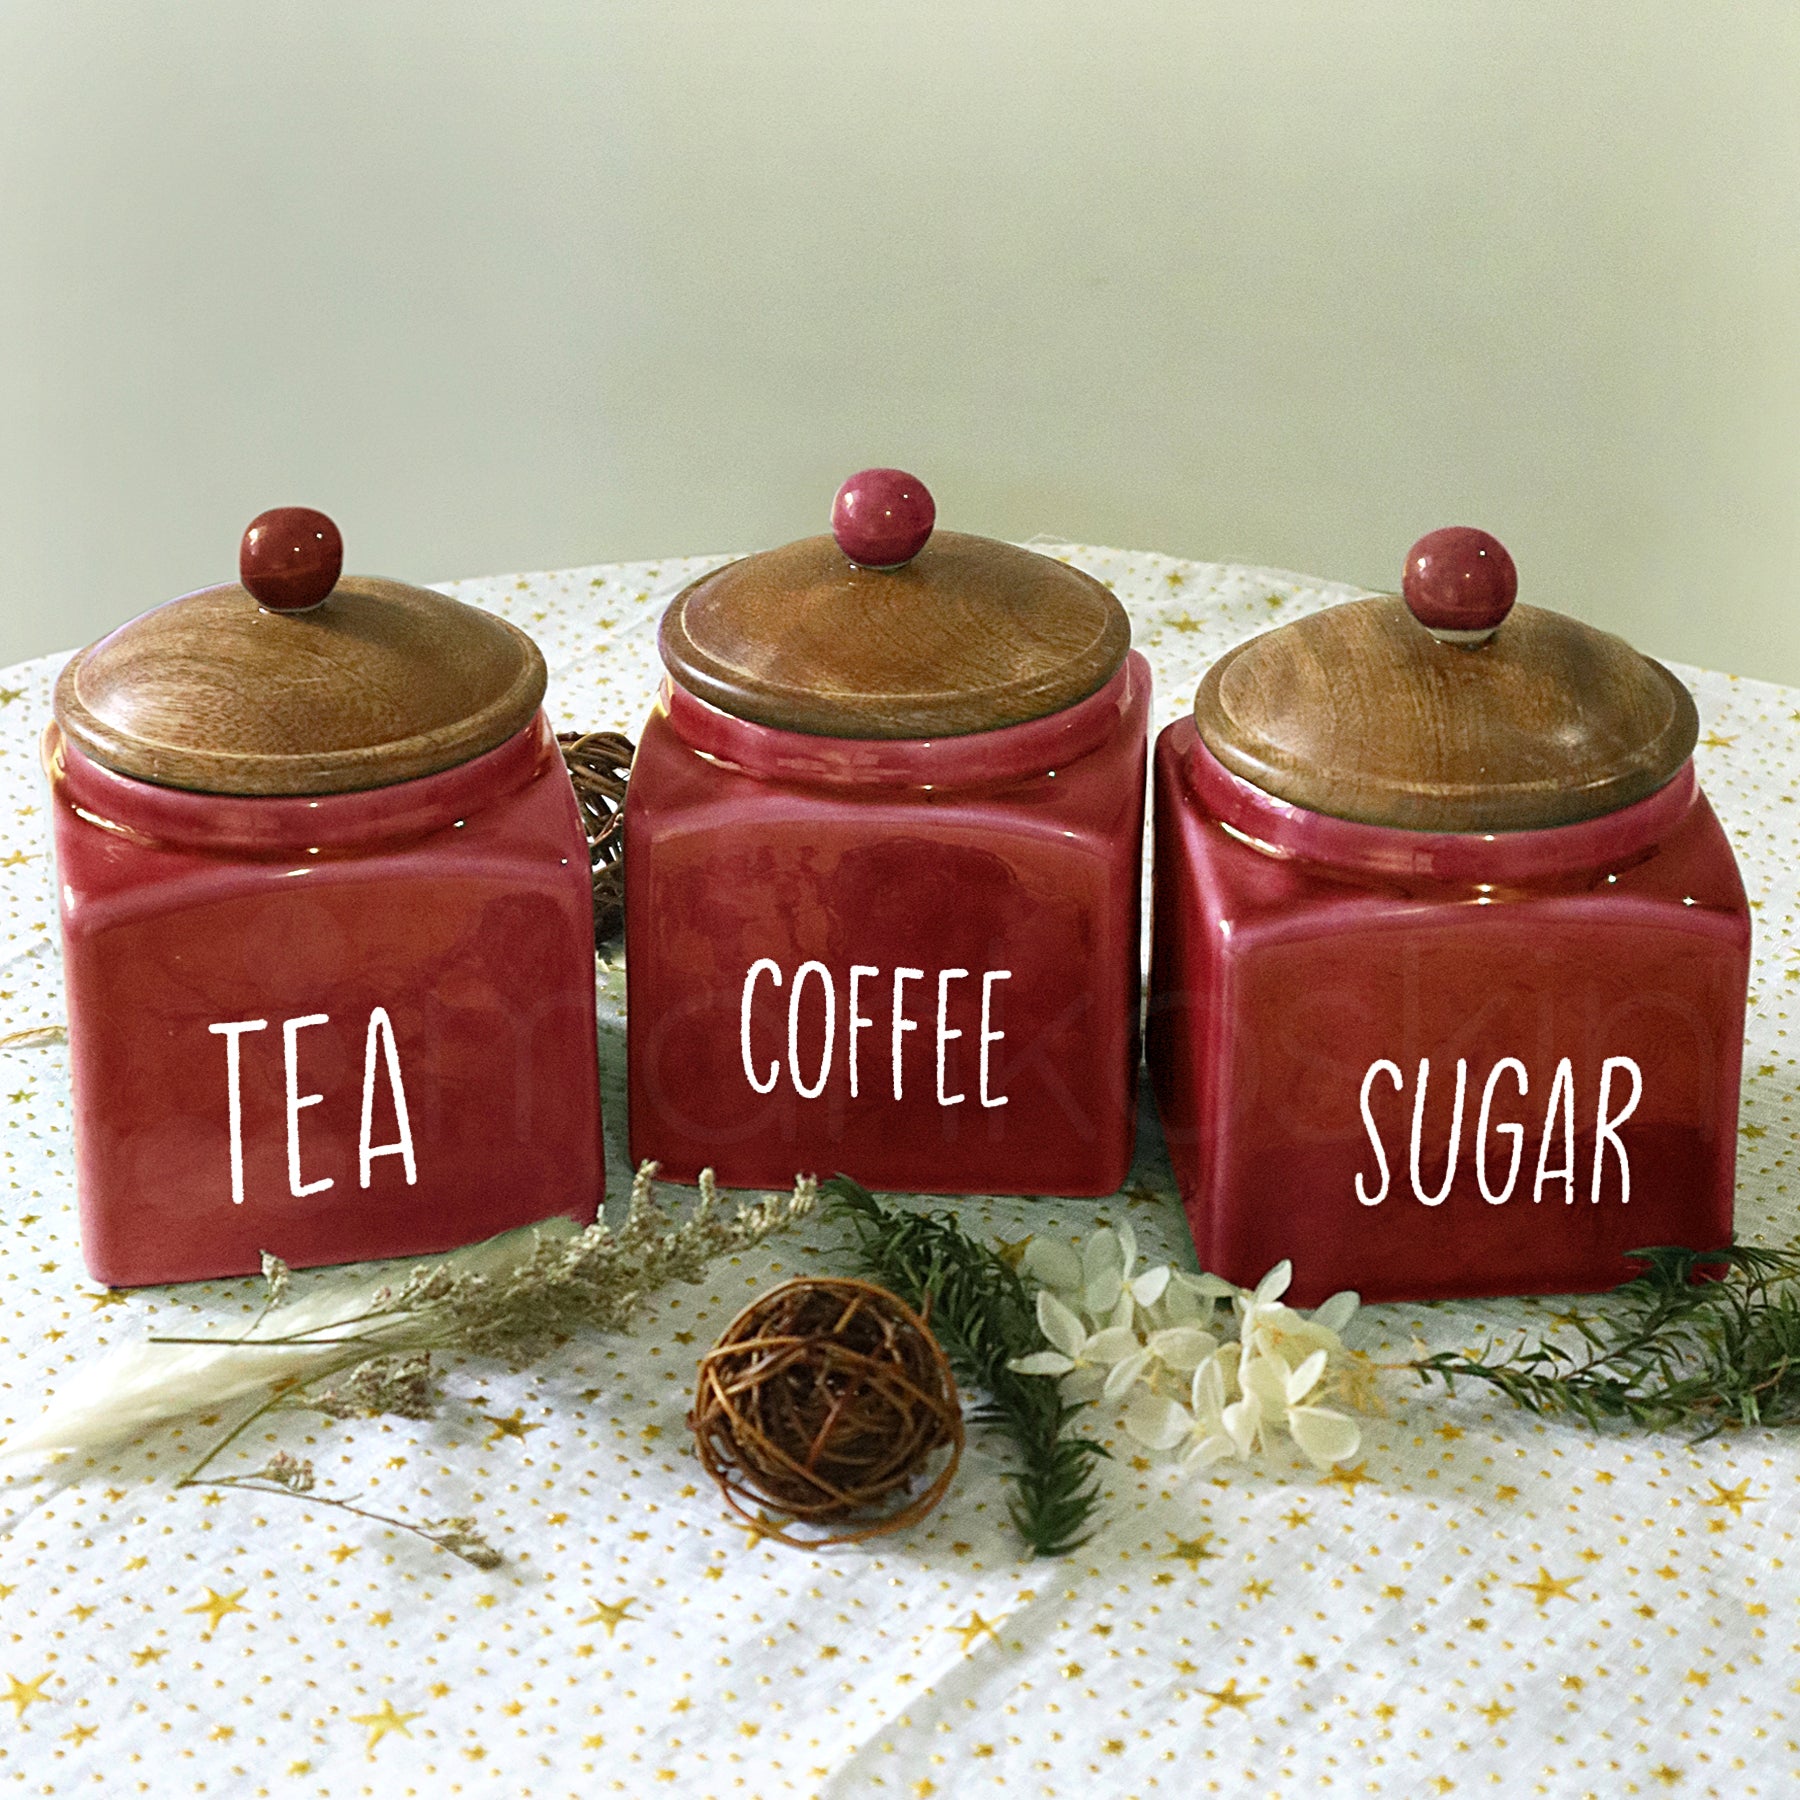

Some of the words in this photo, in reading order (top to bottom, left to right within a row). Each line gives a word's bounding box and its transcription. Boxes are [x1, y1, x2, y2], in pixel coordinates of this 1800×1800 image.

[207, 1006, 418, 1205] TEA
[739, 957, 1012, 1108] COFFEE
[1354, 1055, 1643, 1207] SUGAR
